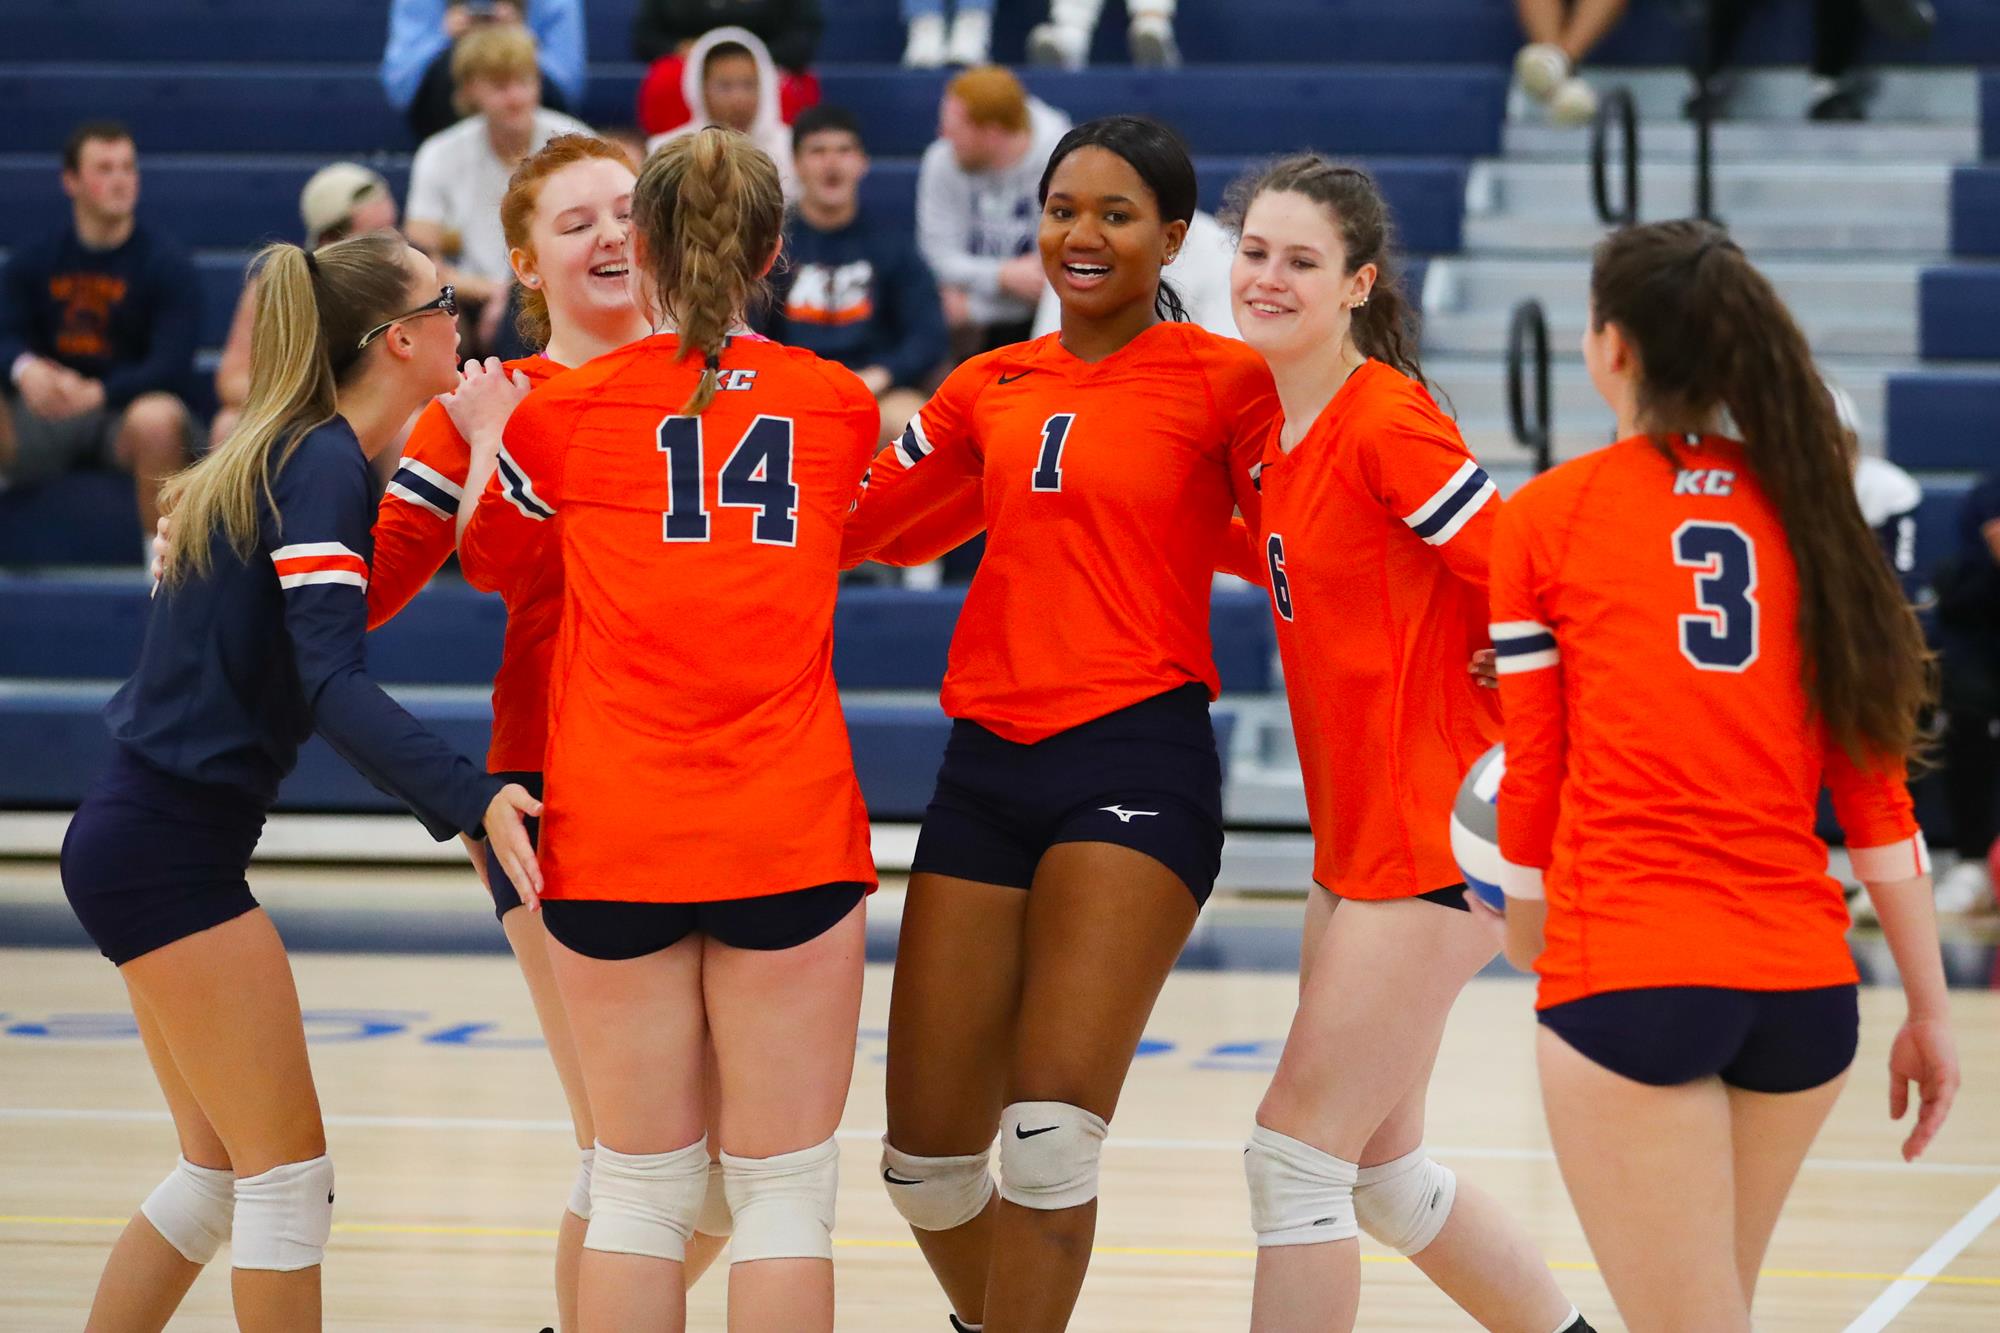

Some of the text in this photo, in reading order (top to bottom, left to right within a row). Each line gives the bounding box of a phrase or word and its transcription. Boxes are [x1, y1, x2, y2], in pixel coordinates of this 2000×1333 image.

[656, 414, 799, 547] 14
[1031, 413, 1077, 493] 1
[1673, 469, 1736, 496] KC
[1266, 532, 1294, 623] 6
[1671, 519, 1760, 673] 3
